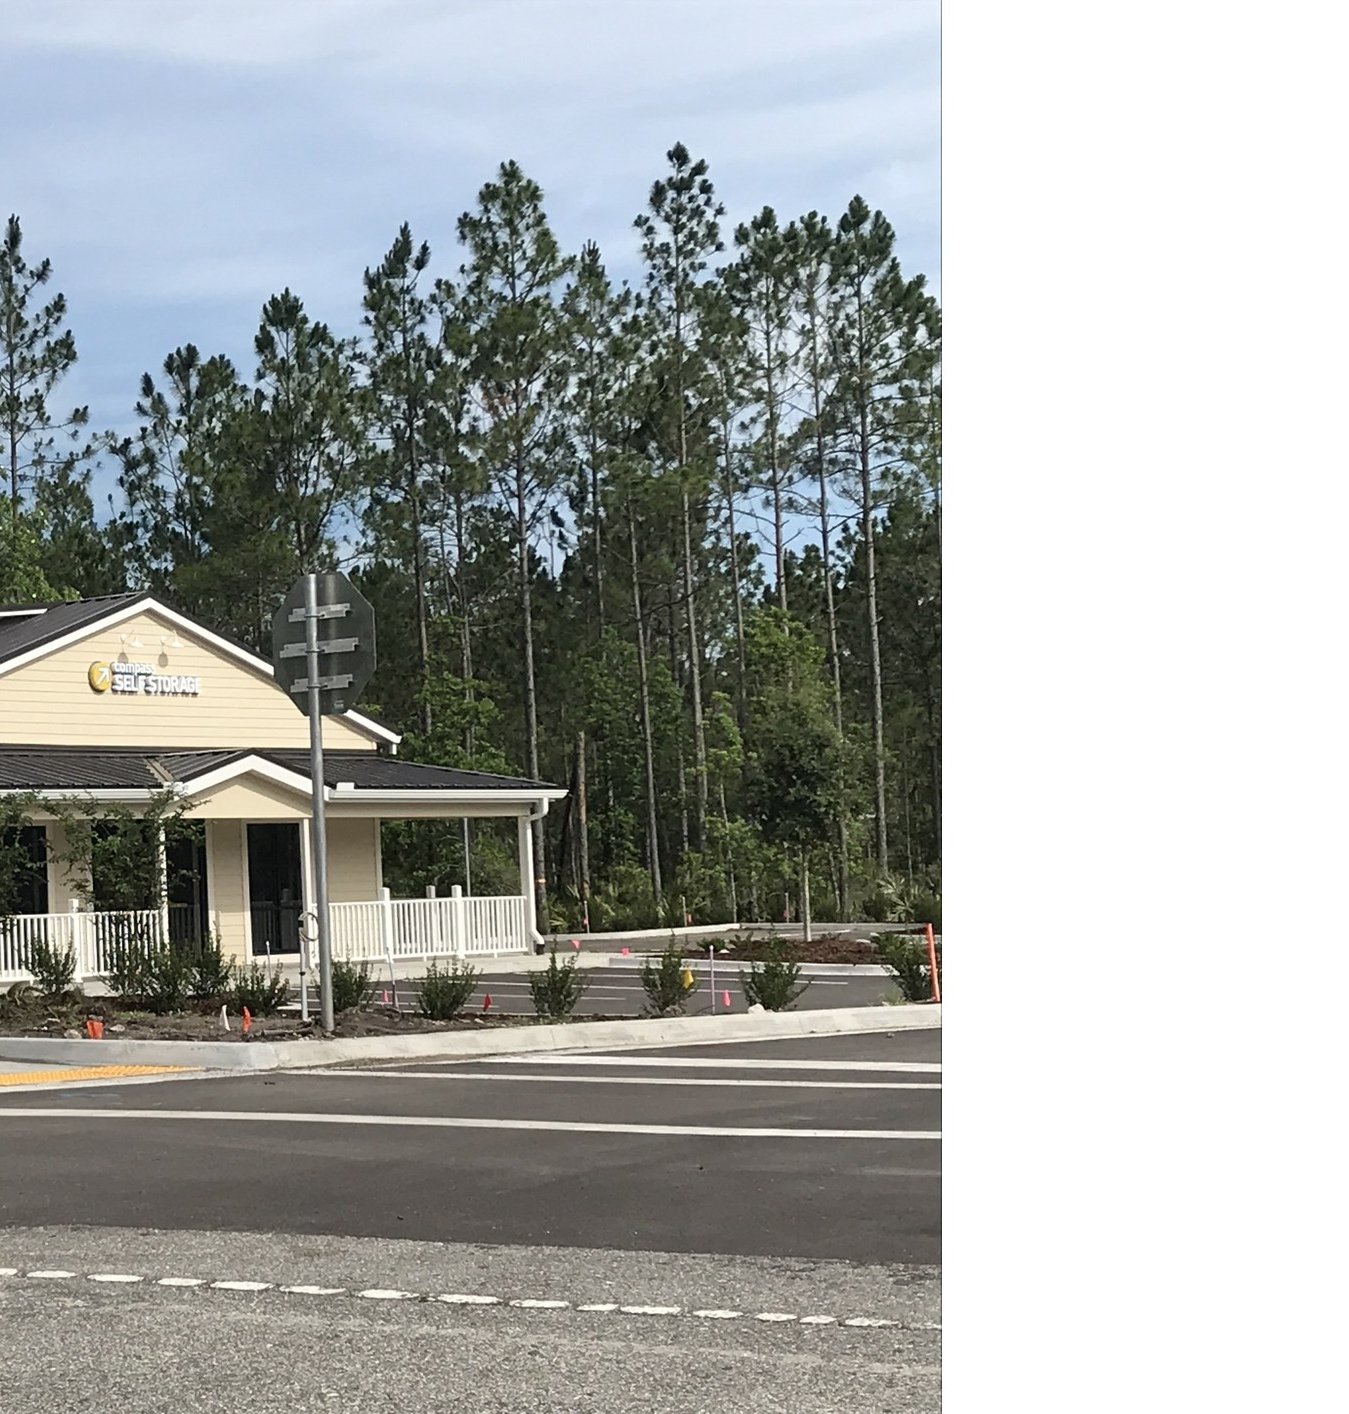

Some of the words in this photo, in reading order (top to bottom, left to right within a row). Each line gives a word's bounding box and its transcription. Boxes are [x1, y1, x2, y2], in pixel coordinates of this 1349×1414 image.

[112, 662, 155, 676] compass
[111, 675, 146, 692] SELF
[145, 676, 203, 693] STORAGE
